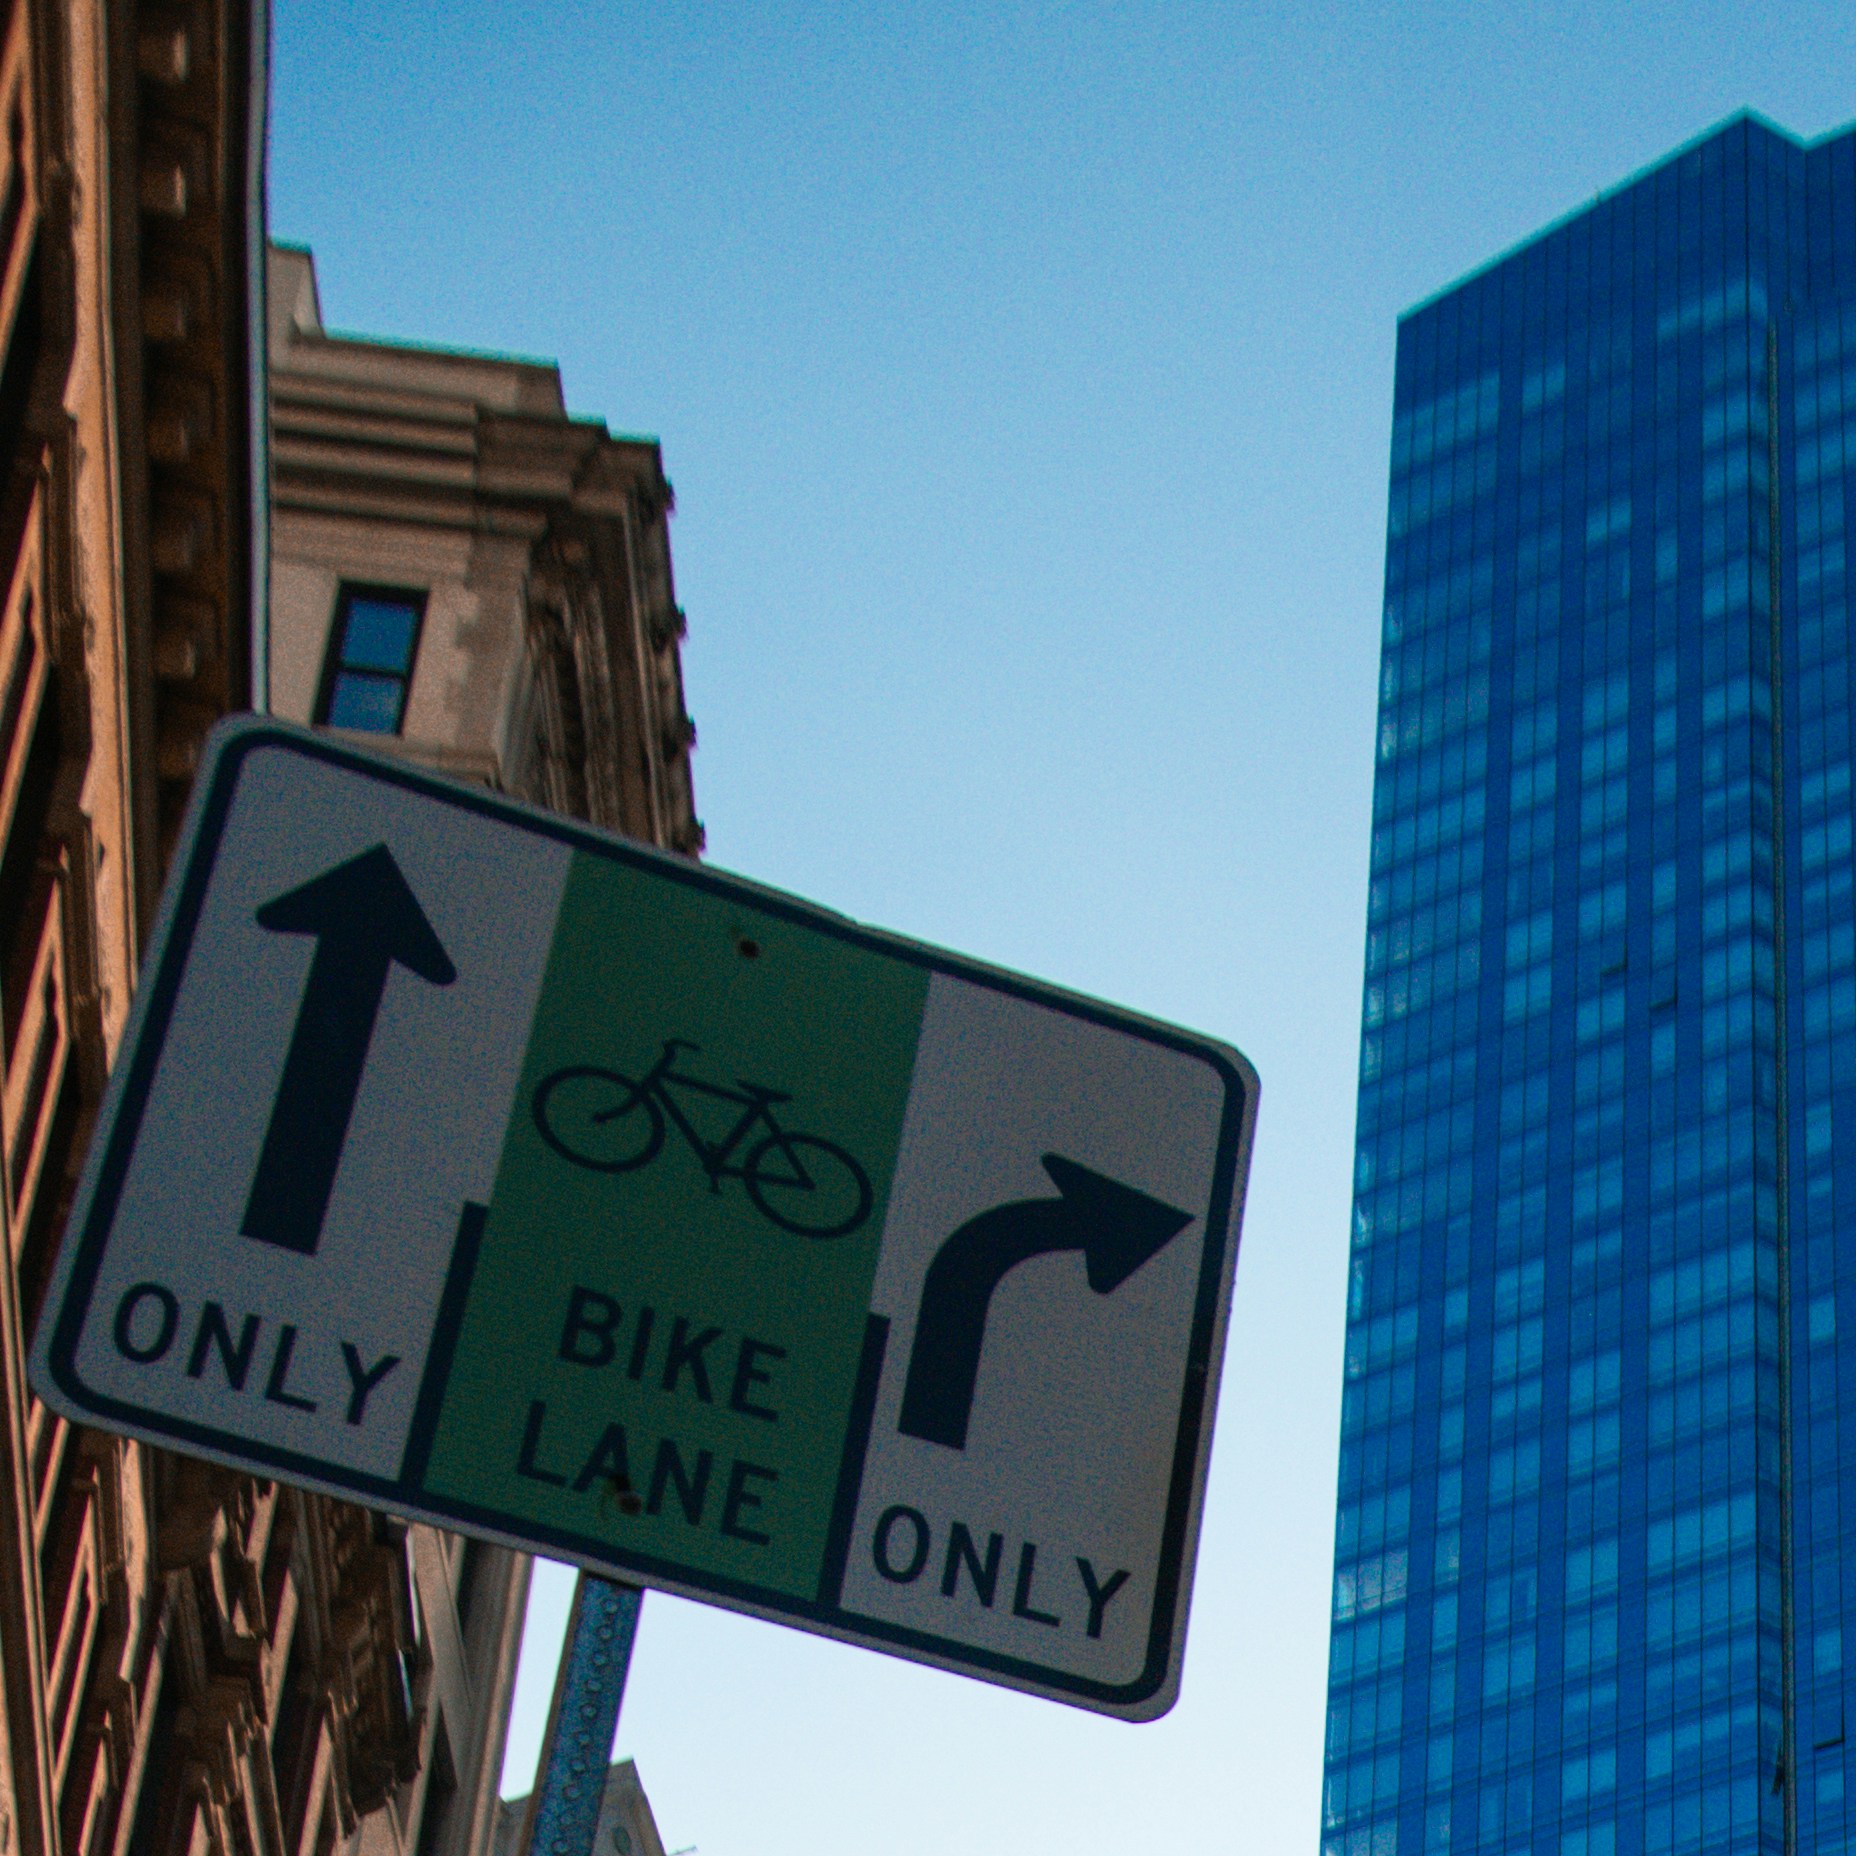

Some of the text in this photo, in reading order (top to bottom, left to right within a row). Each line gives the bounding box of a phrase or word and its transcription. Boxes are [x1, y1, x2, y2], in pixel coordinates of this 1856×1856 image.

[112, 1281, 399, 1426] ONLY
[558, 1286, 788, 1421] BIKE
[516, 1402, 780, 1546] LANE
[872, 1504, 1131, 1639] ONLY
